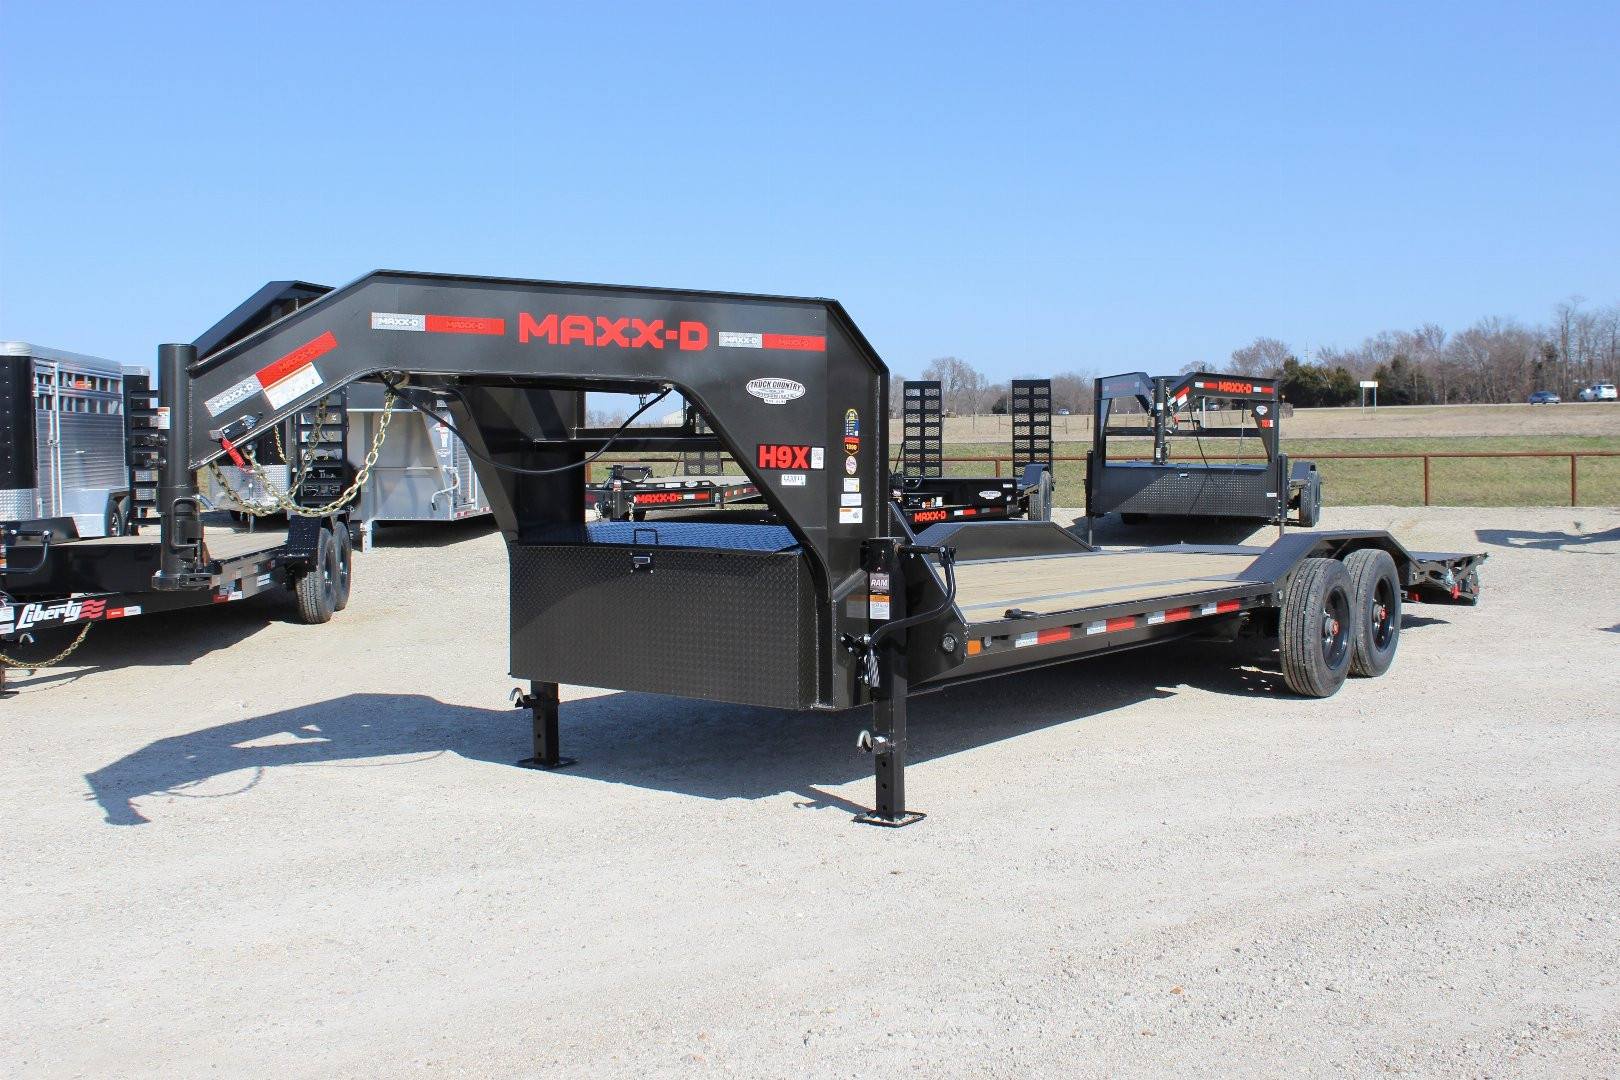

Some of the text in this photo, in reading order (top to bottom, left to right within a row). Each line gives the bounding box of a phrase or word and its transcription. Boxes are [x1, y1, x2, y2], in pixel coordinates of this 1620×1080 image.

[379, 317, 419, 327] MAXX-D
[519, 312, 708, 350] MAXX-D
[724, 335, 757, 344] MAXX-D
[751, 380, 772, 388] TRUCK
[773, 381, 801, 391] COUNTRY
[1218, 381, 1253, 394] MAXX-D
[214, 382, 254, 409] MAXX-D
[759, 445, 810, 469] H9X
[635, 493, 677, 504] MAXX-D
[914, 510, 947, 523] MAXX-D
[870, 579, 888, 587] RAM
[15, 600, 83, 630] Liberty
